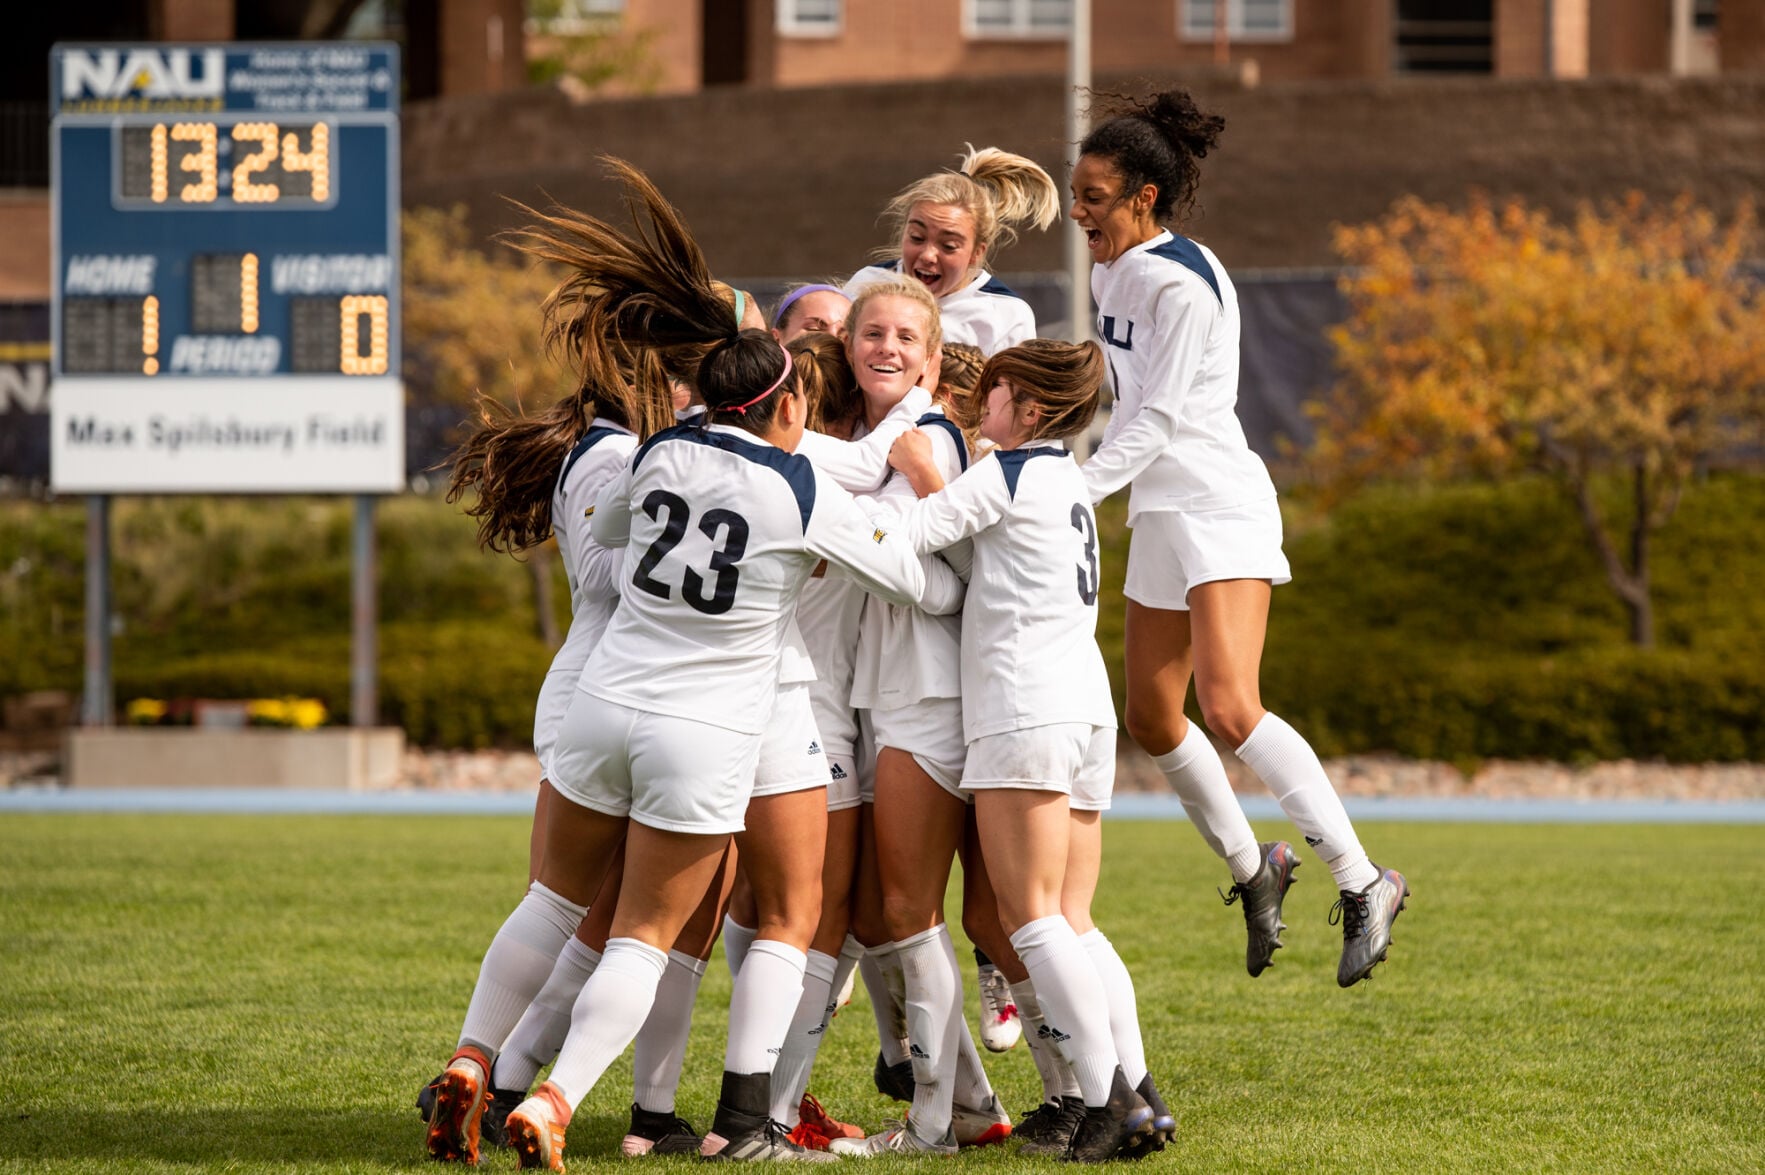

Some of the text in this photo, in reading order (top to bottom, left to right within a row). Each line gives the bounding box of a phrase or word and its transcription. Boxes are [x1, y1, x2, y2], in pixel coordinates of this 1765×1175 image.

[62, 47, 224, 98] NAU
[65, 254, 156, 294] HOME
[240, 252, 259, 333] 1
[271, 254, 391, 294] VISITOR
[169, 335, 281, 373] PERIOD
[340, 295, 389, 375] 0
[66, 413, 384, 457] Max Spilsbury Field
[632, 489, 749, 615] 23
[1070, 502, 1097, 606] 3
